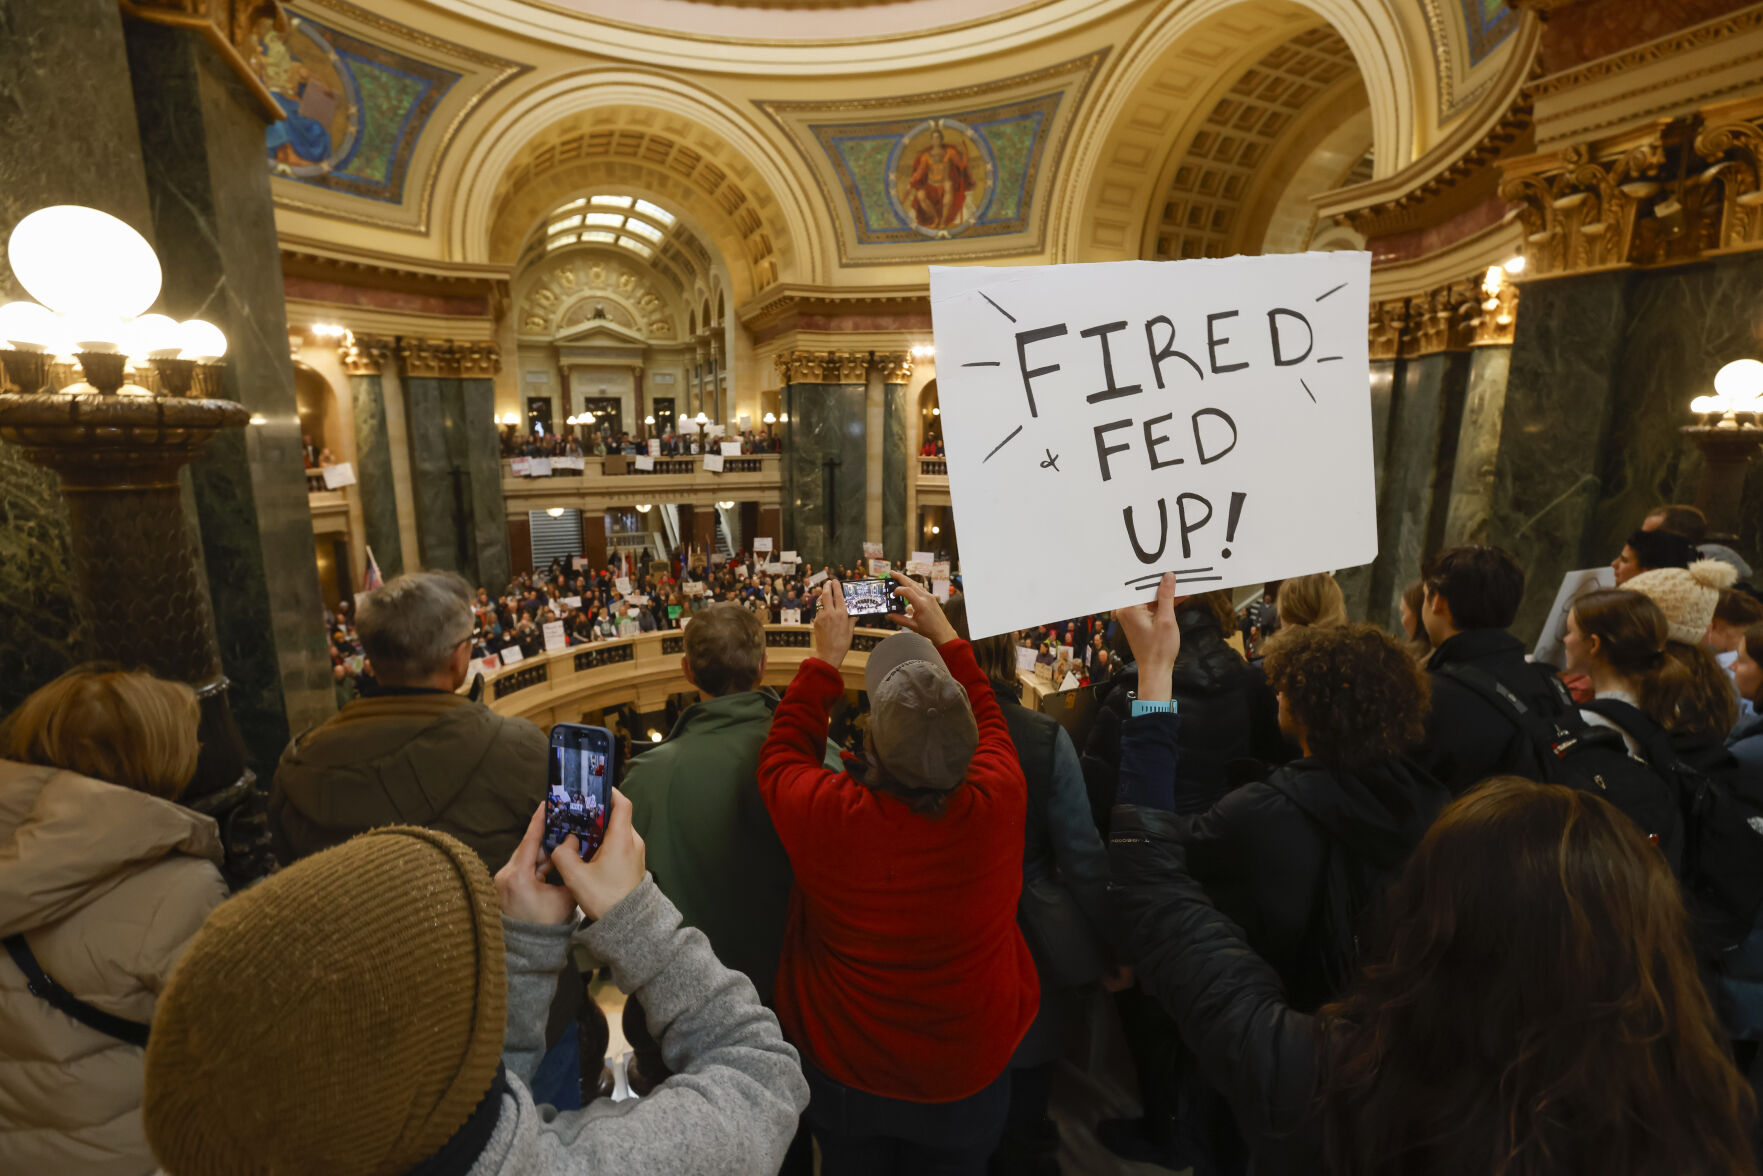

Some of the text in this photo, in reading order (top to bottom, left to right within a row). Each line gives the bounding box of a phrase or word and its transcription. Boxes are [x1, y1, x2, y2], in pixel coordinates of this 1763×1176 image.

[1015, 306, 1313, 418] FIRED
[1093, 407, 1238, 482] FED
[1122, 491, 1247, 565] UP!
